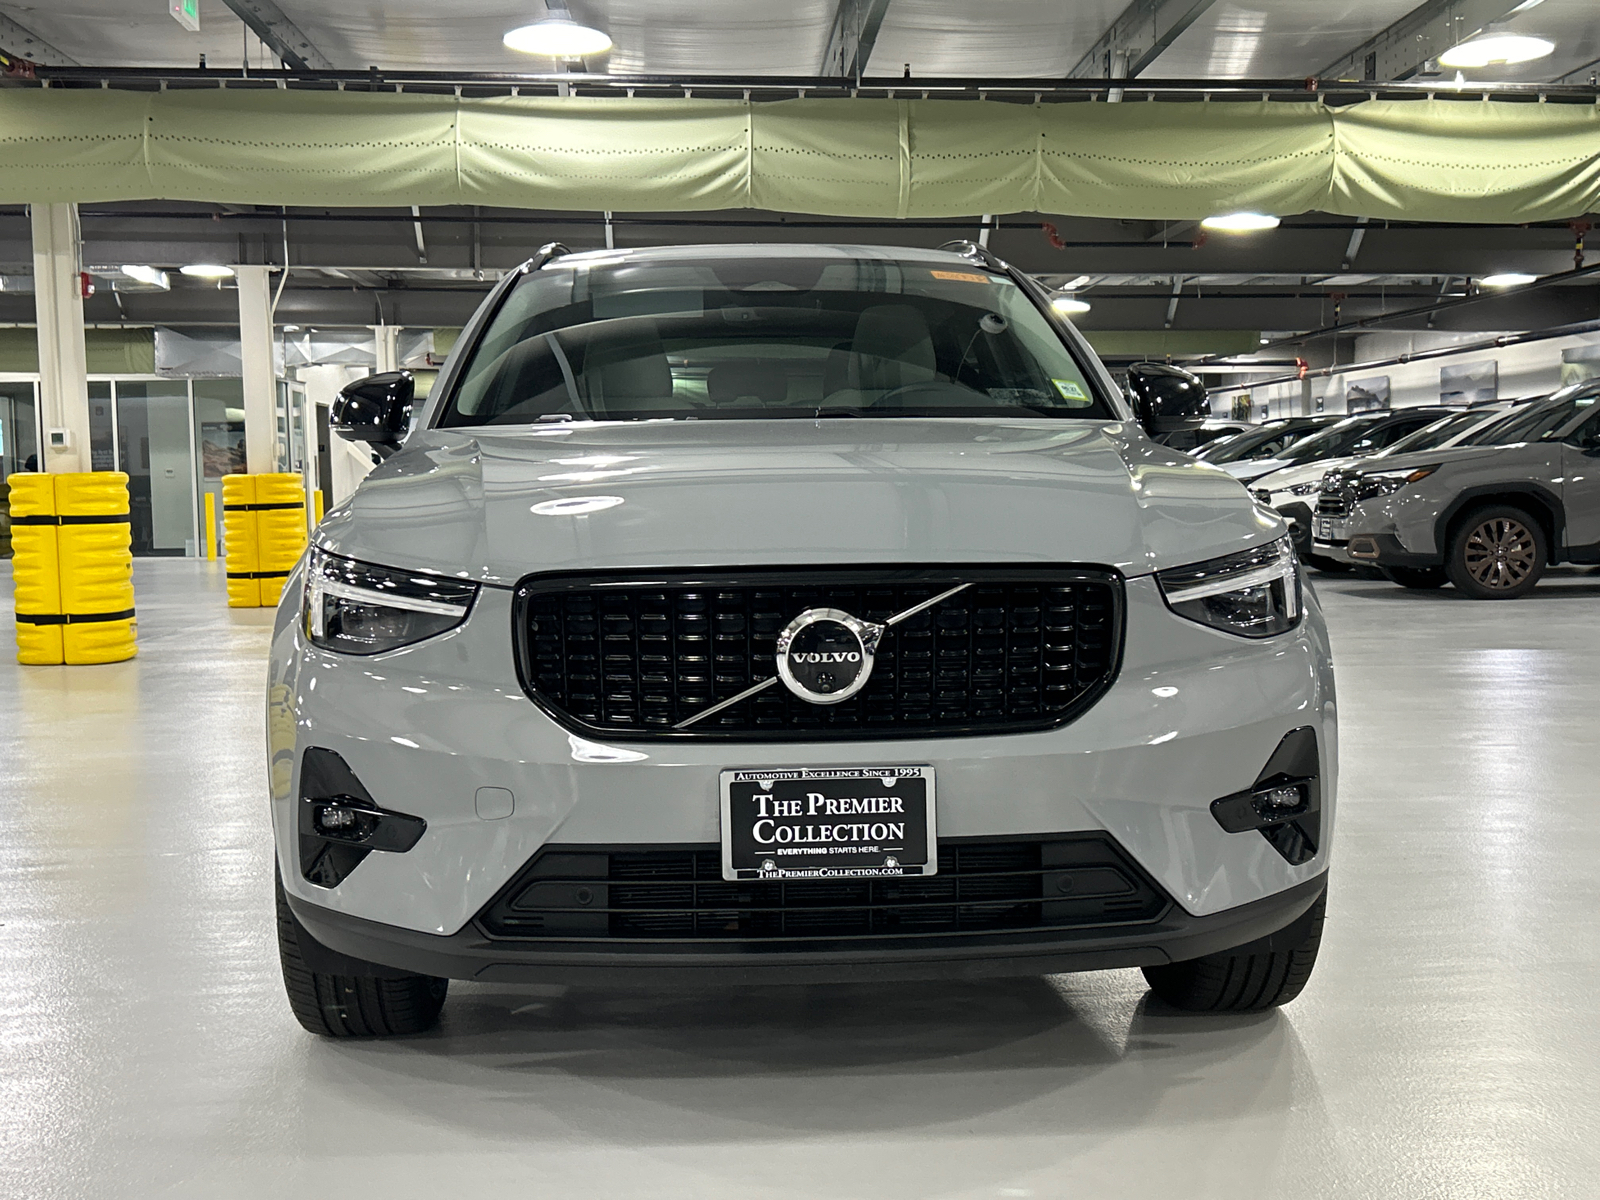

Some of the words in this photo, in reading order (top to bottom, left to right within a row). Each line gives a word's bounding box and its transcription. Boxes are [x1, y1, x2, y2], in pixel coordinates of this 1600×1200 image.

[790, 652, 860, 663] VOLVO
[862, 768, 891, 778] SINCE
[894, 767, 920, 777] 1995
[752, 794, 803, 817] THE
[806, 793, 904, 816] PREMIER
[752, 819, 905, 844] COLLECTION
[777, 847, 828, 856] EVERYTHING
[829, 846, 857, 855] STARTS
